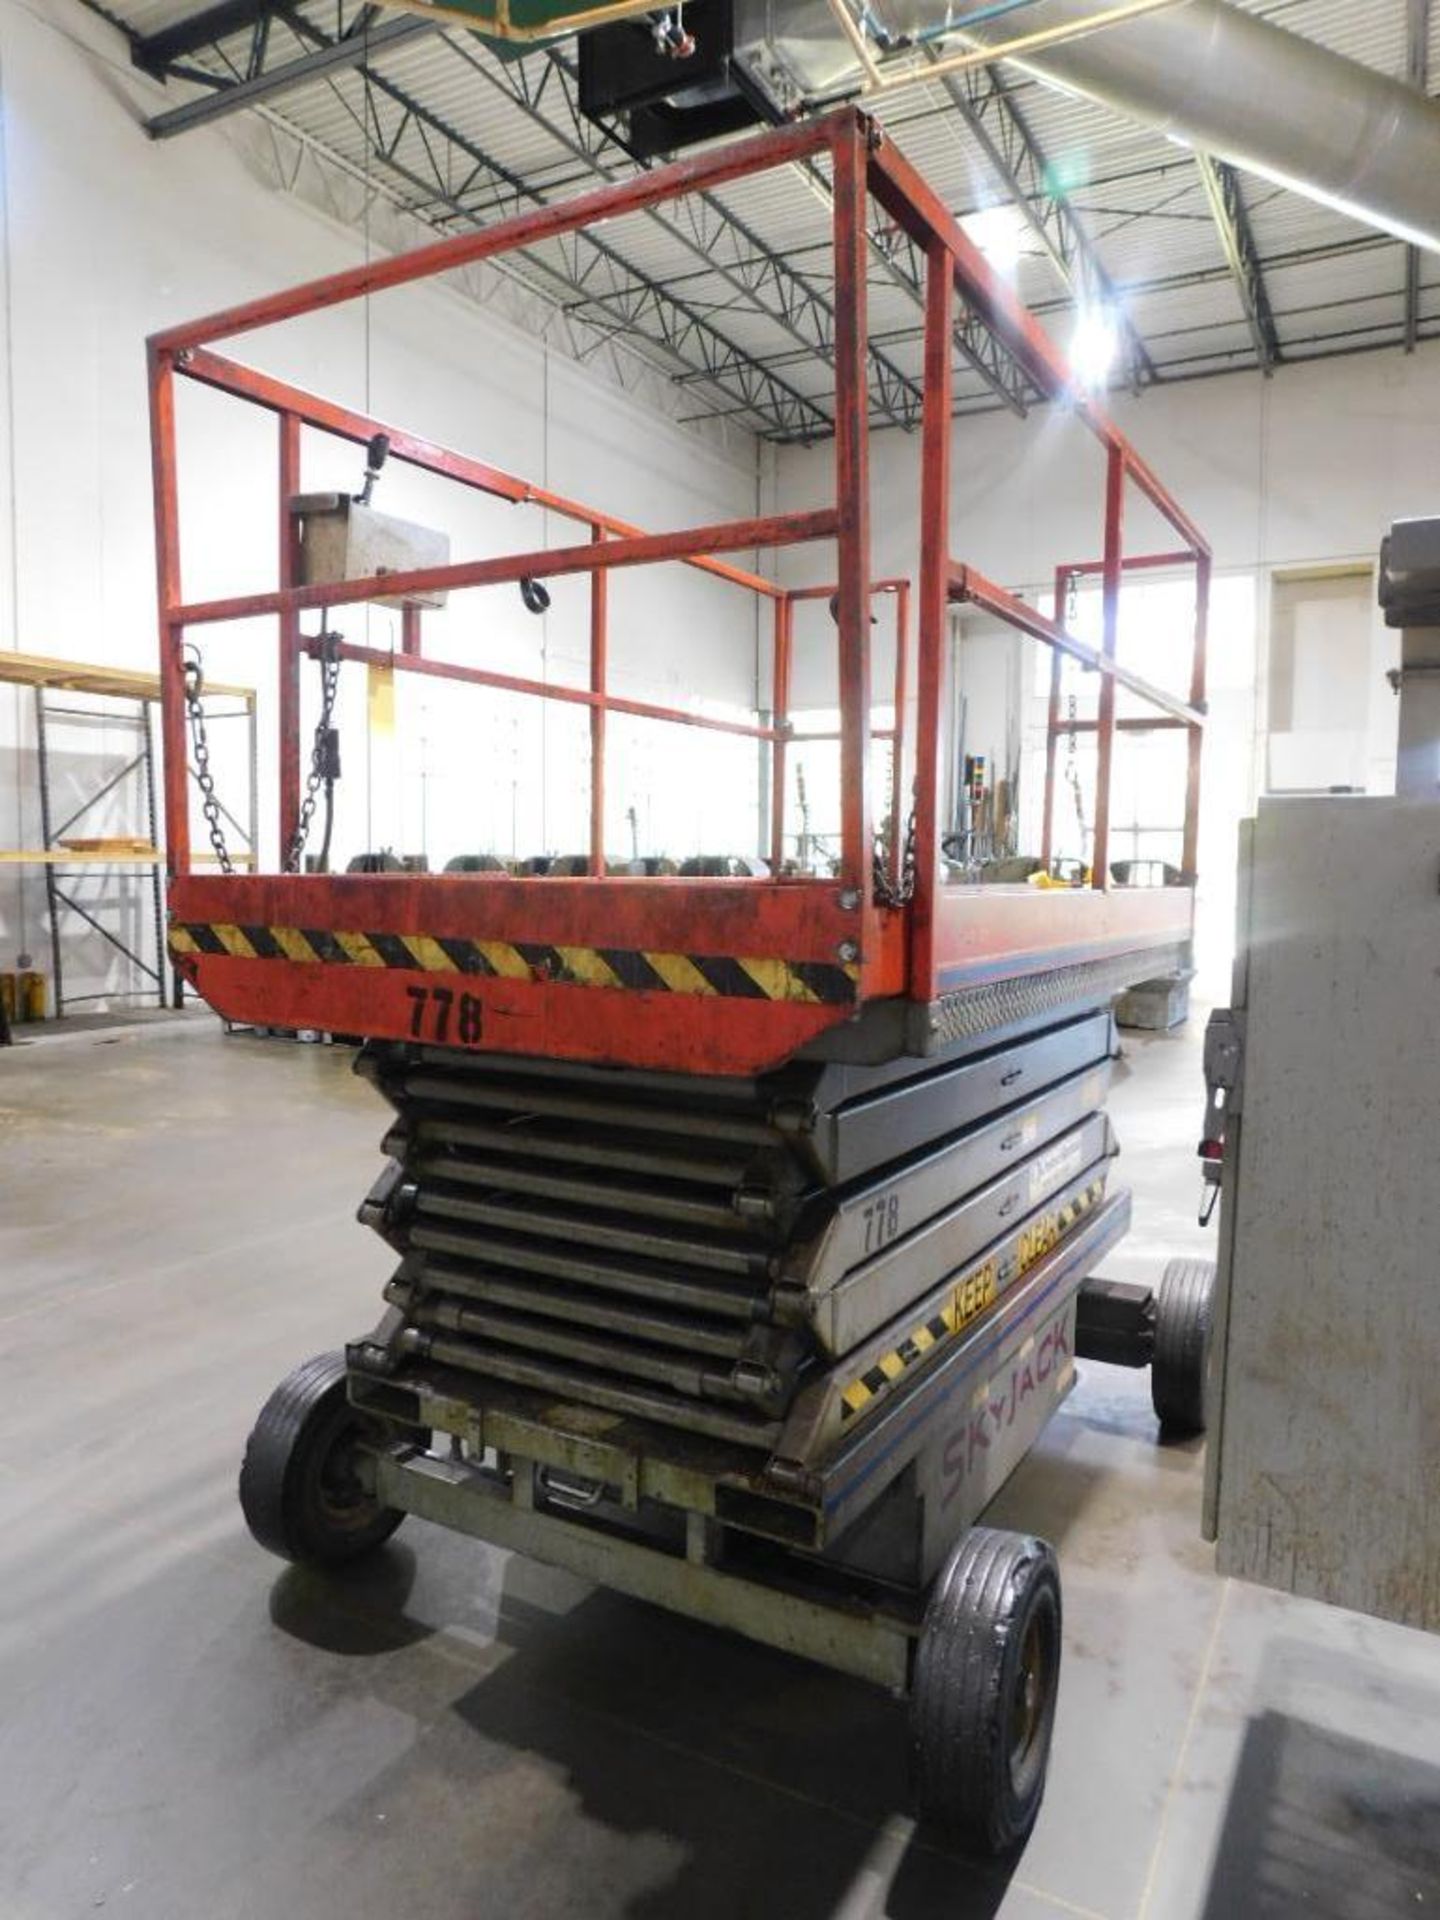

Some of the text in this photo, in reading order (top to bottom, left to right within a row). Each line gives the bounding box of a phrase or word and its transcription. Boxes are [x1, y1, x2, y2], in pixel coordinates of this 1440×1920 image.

[406, 986, 482, 1044] 778
[863, 1193, 899, 1254] 778
[954, 1259, 994, 1331] KEEP
